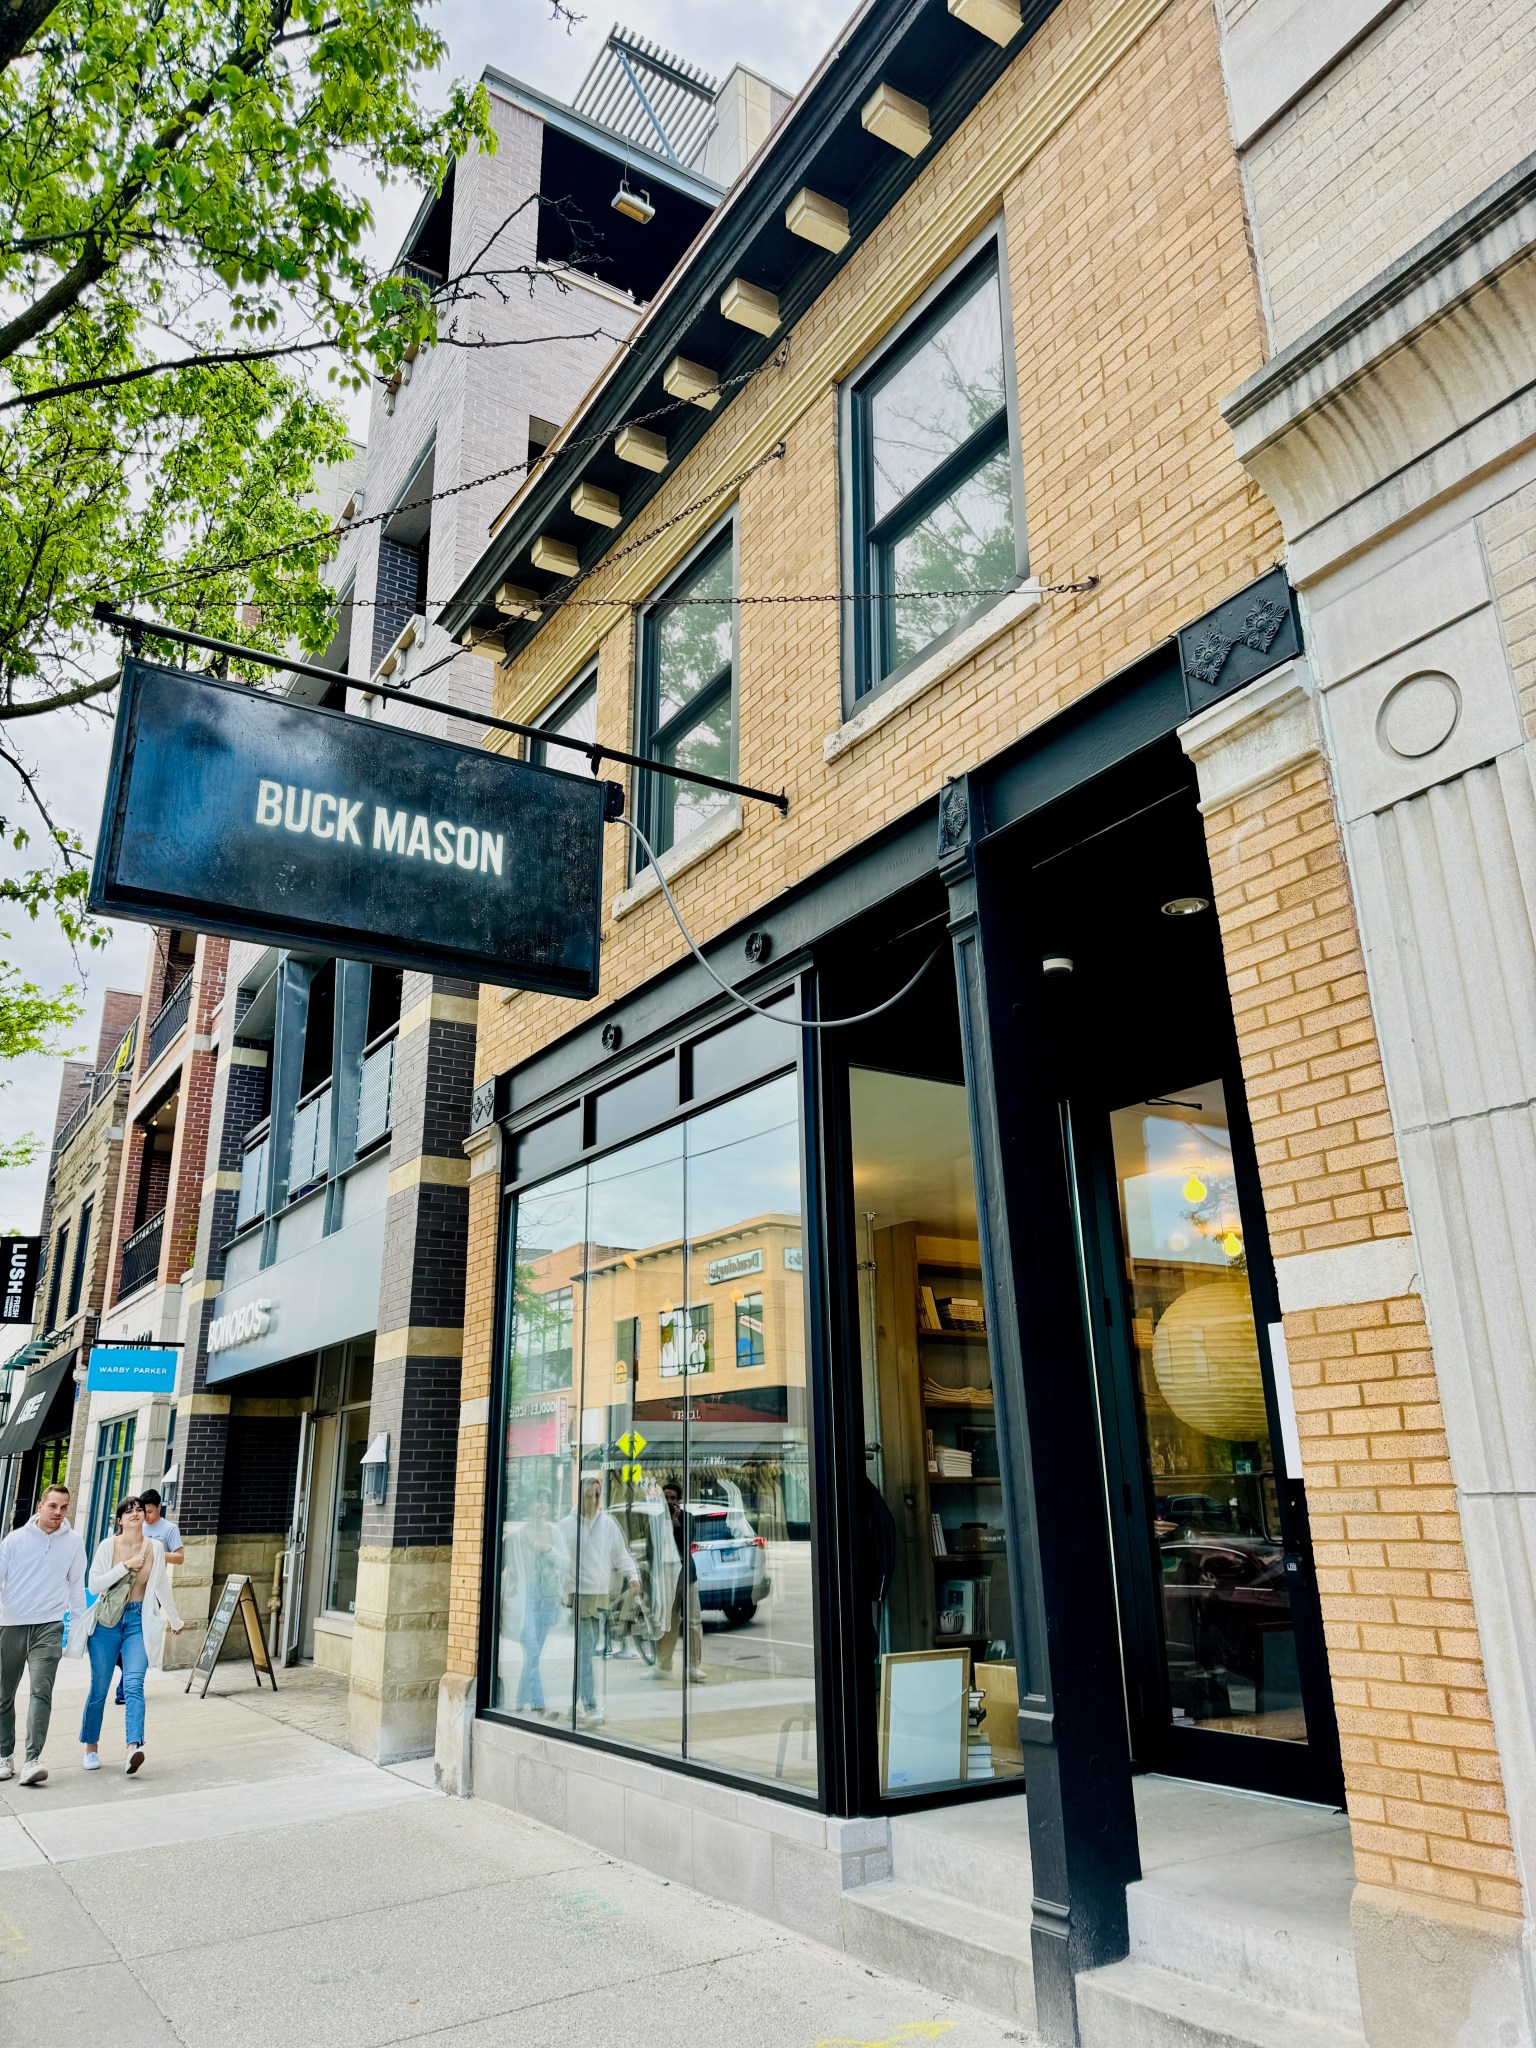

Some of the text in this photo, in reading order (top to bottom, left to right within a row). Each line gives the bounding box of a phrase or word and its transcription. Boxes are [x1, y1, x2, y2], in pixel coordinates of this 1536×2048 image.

[256, 780, 504, 876] BUCK MASON
[7, 1243, 28, 1294] LUSH
[12, 1295, 21, 1318] FRESH
[207, 1299, 271, 1353] BONOBOS
[99, 1366, 167, 1375] WARBY PARKER
